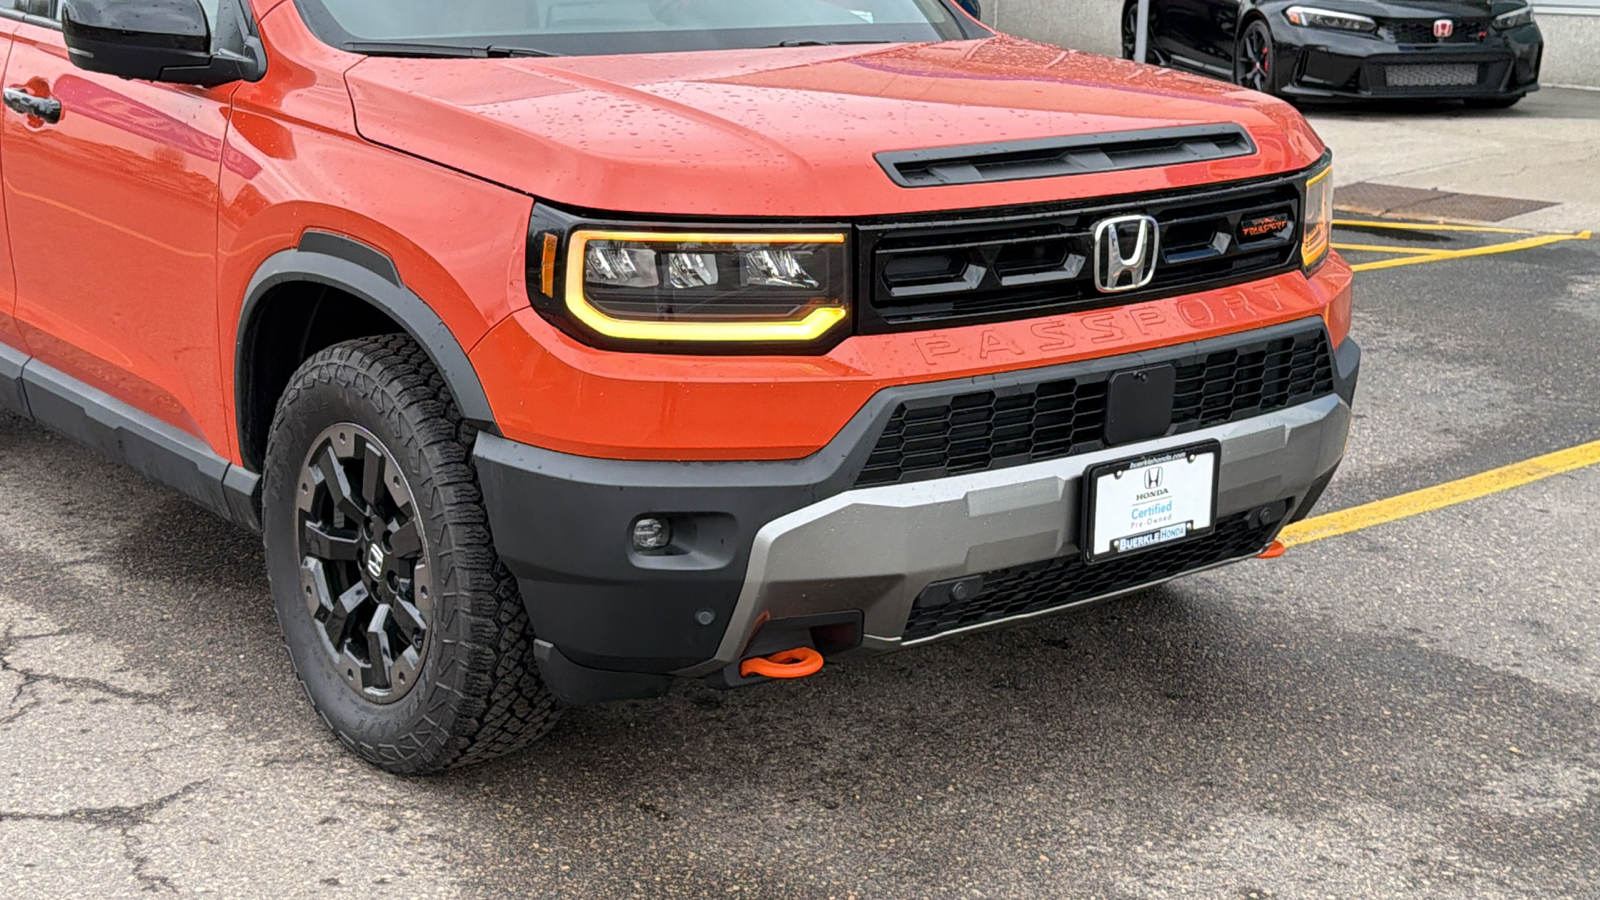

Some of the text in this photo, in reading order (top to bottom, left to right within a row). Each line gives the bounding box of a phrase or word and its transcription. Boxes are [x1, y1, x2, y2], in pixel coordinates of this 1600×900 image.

[913, 281, 1289, 367] PASSPORT
[1135, 488, 1169, 501] HONDA
[1131, 500, 1173, 520] Certified
[1130, 514, 1173, 529] Pre-Owned
